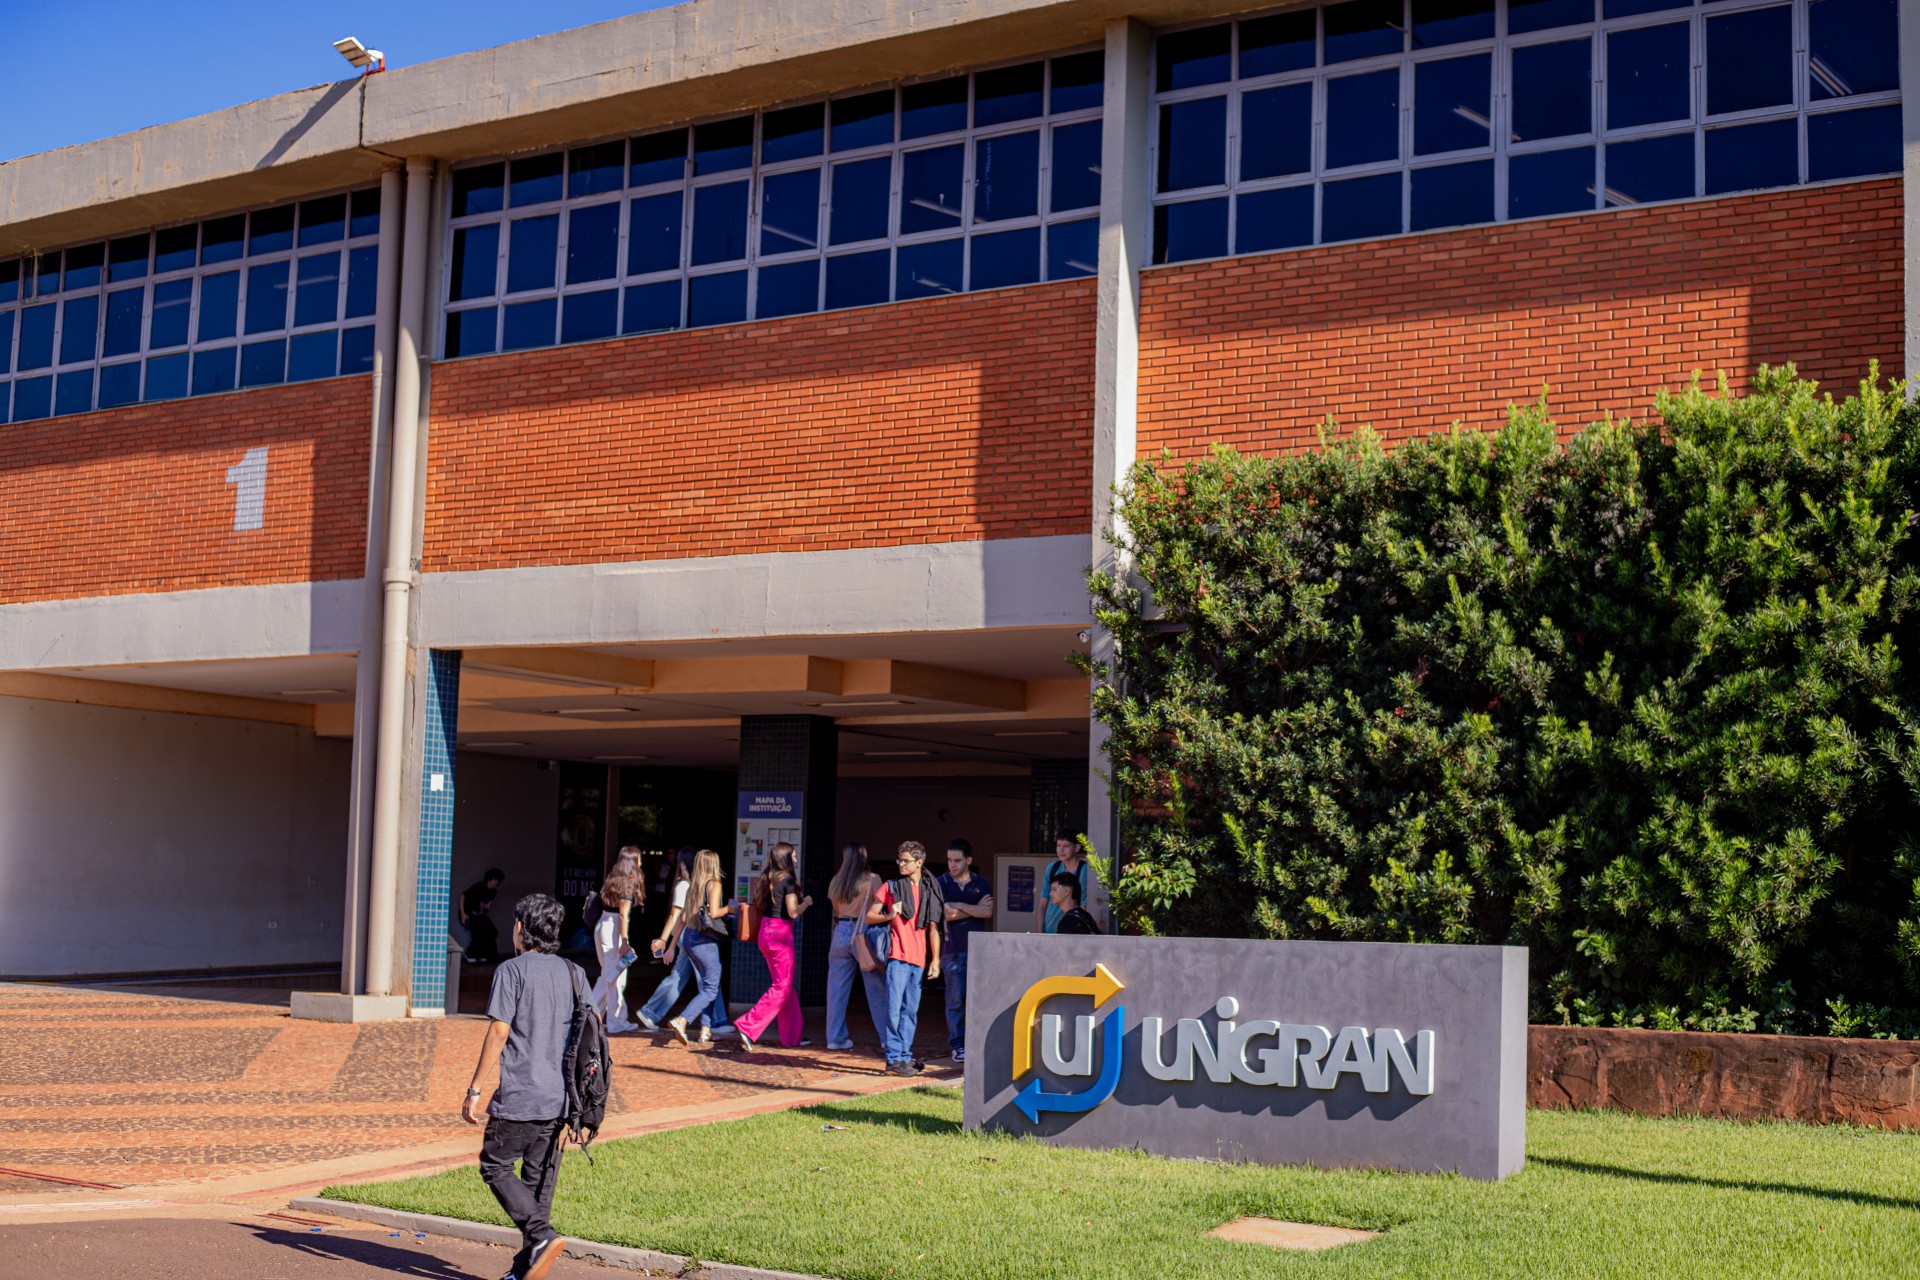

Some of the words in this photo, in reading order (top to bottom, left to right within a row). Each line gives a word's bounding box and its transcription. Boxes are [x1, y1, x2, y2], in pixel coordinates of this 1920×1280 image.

[226, 447, 268, 531] 1
[749, 803, 792, 812] INSTITUIÇÃO
[563, 879, 578, 897] DO
